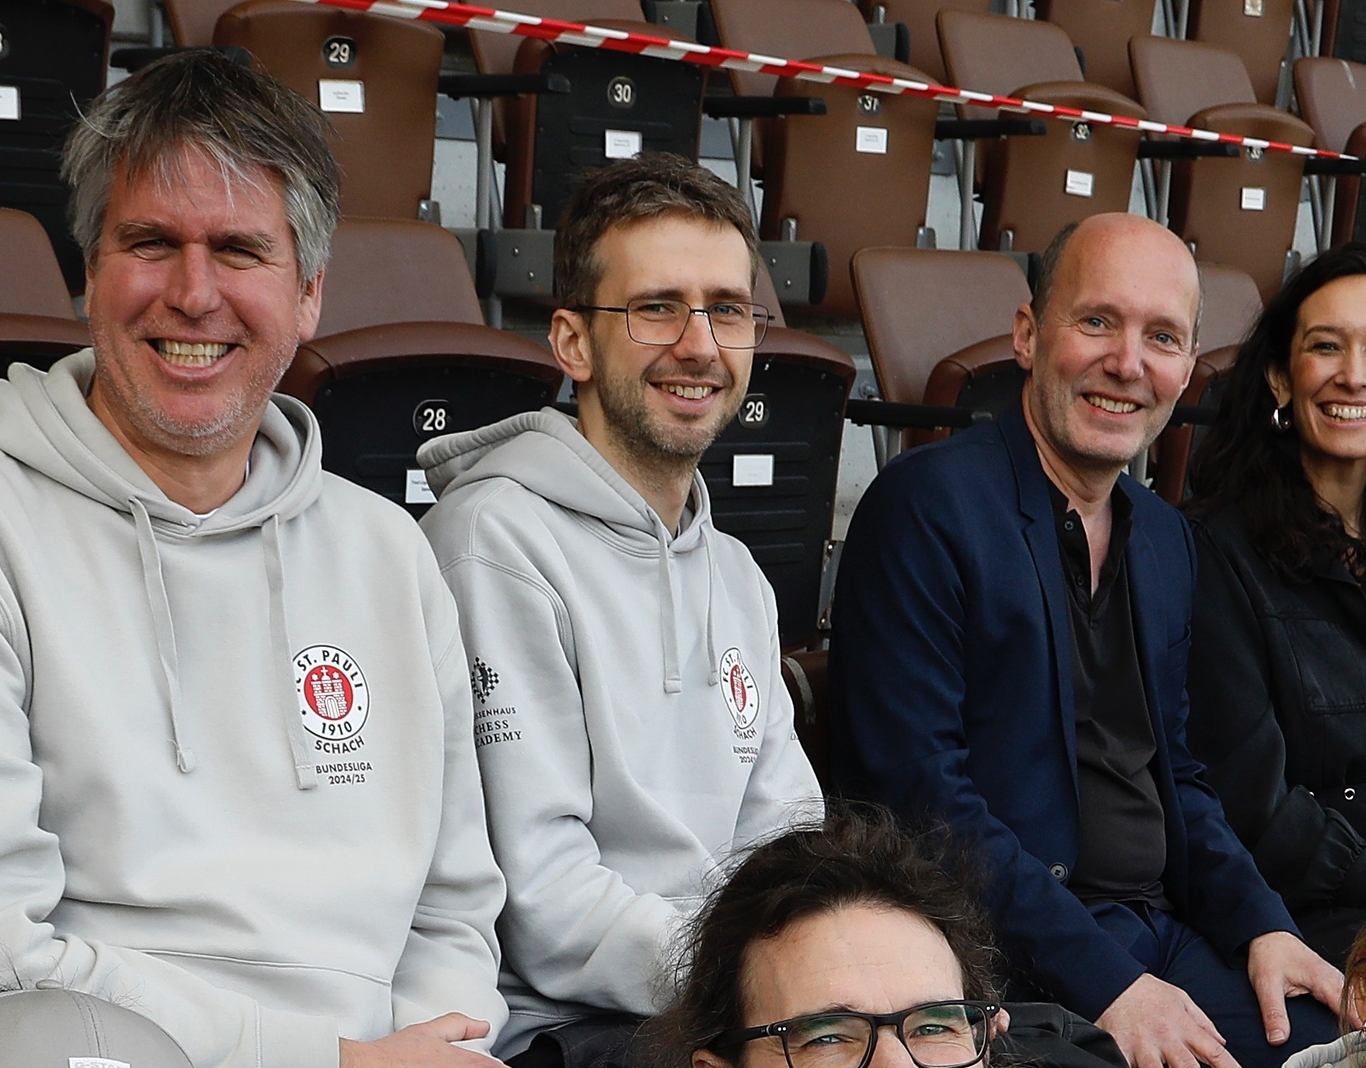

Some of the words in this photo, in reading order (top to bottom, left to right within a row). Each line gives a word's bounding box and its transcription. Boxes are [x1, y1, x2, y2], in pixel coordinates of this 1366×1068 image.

[328, 42, 350, 63] 29
[614, 84, 631, 102] 30
[422, 408, 446, 431] 28
[745, 401, 764, 422] 29
[297, 654, 317, 672] ST.
[322, 650, 363, 688] PAULI
[321, 721, 352, 736] 1910
[314, 735, 365, 755] SCHACH
[316, 762, 373, 774] BUNDESLIGA
[328, 774, 366, 786] 2024/25
